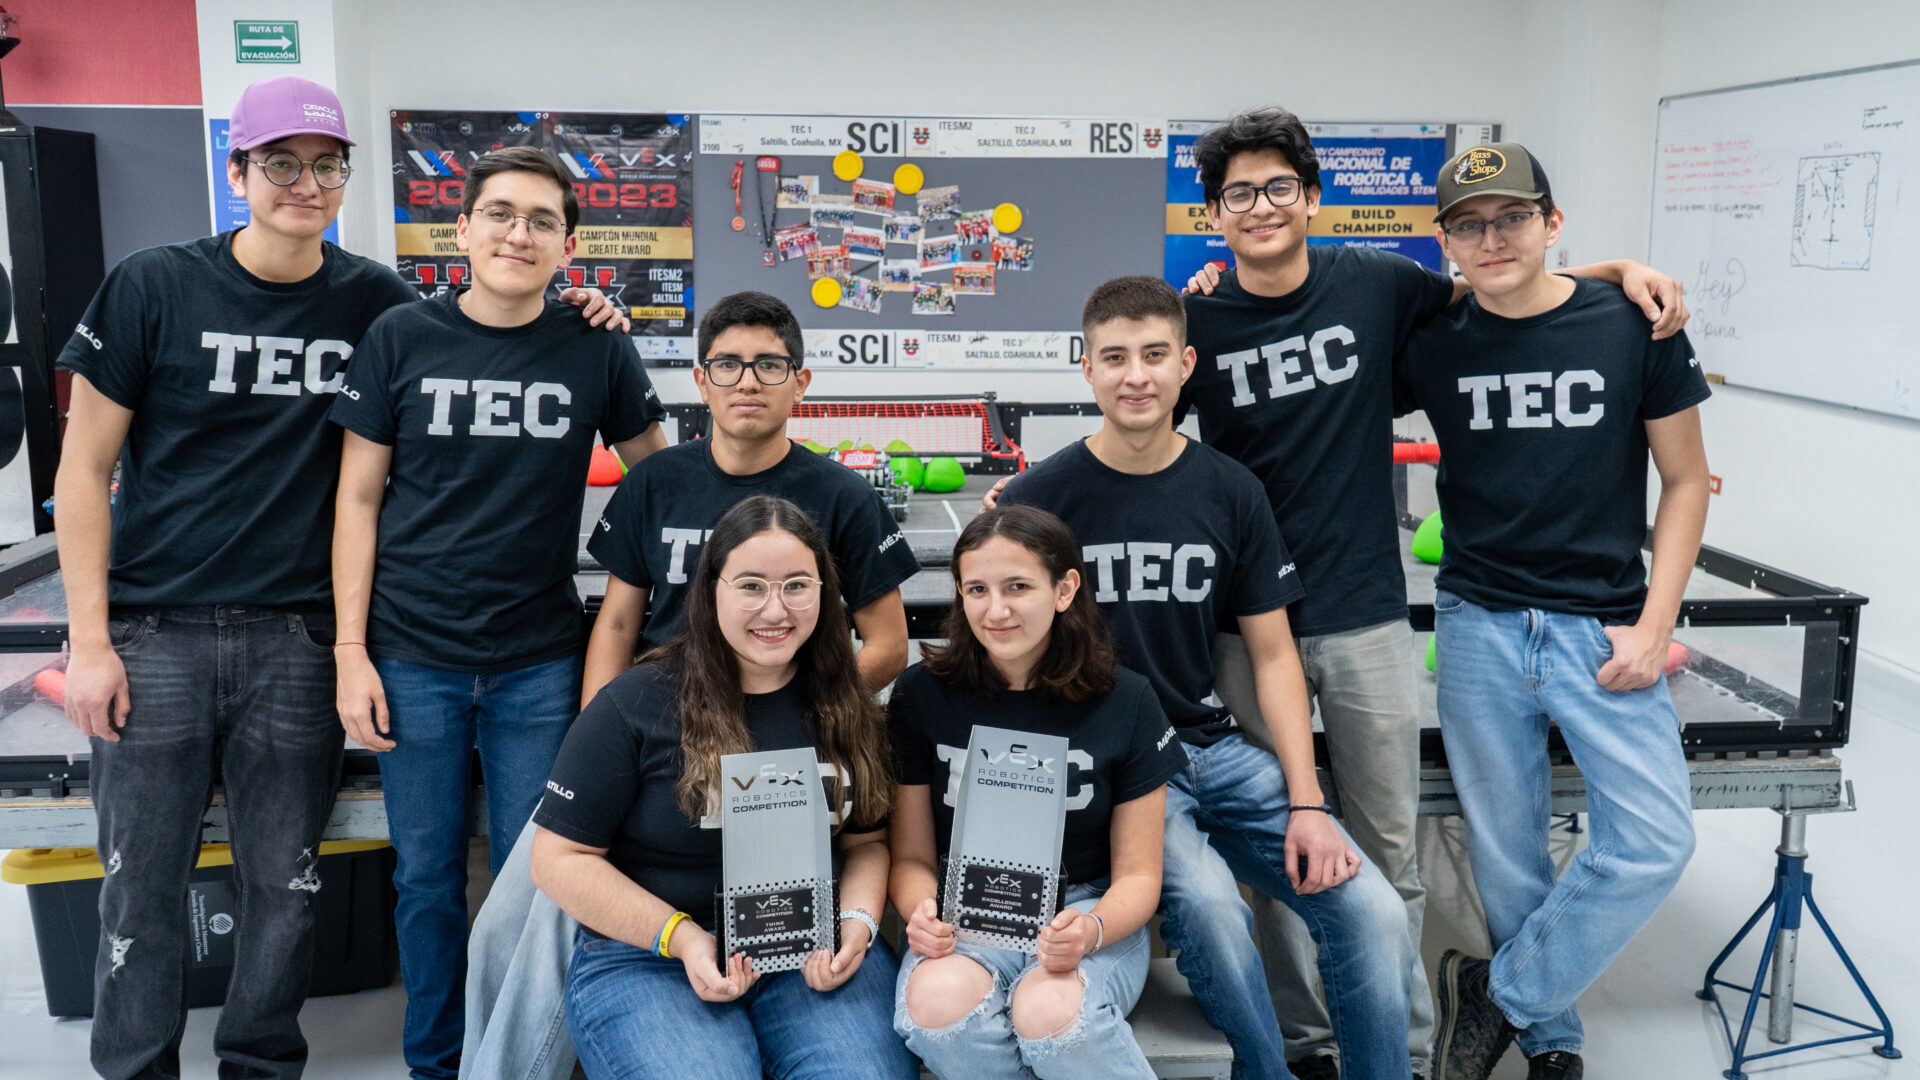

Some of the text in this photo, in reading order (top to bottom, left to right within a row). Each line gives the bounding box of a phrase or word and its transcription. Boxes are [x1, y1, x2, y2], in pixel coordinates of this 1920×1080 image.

[241, 51, 296, 60] EVACUACIÓN
[302, 103, 338, 115] ORACLE
[790, 125, 806, 134] TEC
[938, 121, 973, 131] ITESM2
[1014, 126, 1036, 135] TEC 2
[760, 137, 789, 147] Saltillo,
[791, 138, 826, 147] Coahuila,
[847, 121, 899, 154] SCI
[1059, 139, 1072, 147] MX
[1090, 122, 1133, 154] RES
[702, 143, 720, 152] 3100
[1328, 147, 1386, 156] CAMPEONATO
[619, 147, 677, 167] VEX
[1470, 151, 1492, 160] Bass
[1318, 156, 1413, 171] NACIONAL DE
[1469, 158, 1486, 169] Pro
[1469, 164, 1498, 176] Shops
[1333, 170, 1424, 186] ROBÓTICA &
[408, 180, 465, 205] 20
[571, 182, 677, 208] 2023
[1350, 185, 1437, 195] HABILIDADES STEM
[1351, 209, 1396, 219] BUILD
[430, 228, 458, 239] CAMPE
[1332, 223, 1413, 233] CHAMPION
[579, 229, 659, 242] CAMPEÓN MUNDIAL
[588, 244, 651, 255] CREATE AWARD
[1345, 240, 1400, 249] Nivel Superior
[649, 268, 683, 281] ITESM2
[661, 283, 684, 292] ITESM
[652, 293, 684, 304] SALTILLO
[1002, 338, 1016, 347] TEC
[820, 350, 833, 358] MX
[838, 334, 889, 364] SCI
[1046, 351, 1059, 359] MX
[201, 331, 354, 396] TEC
[1216, 324, 1359, 408] TEC
[1457, 369, 1605, 430] TEC
[420, 377, 572, 439] TEC
[878, 530, 904, 554] MÉX
[1082, 541, 1217, 603] TEC
[980, 743, 1056, 774] VEX
[731, 763, 805, 791] VEX
[936, 743, 1094, 811] TC
[978, 767, 1055, 785] ROBOTICS
[977, 777, 1054, 795] COMPETITION
[732, 789, 807, 803] ROBOTICS
[732, 799, 807, 813] COMPETITION
[986, 873, 1022, 888] VEX
[984, 884, 1022, 893] ROBOTICS
[984, 888, 1022, 898] COMPETITION
[755, 894, 793, 910] VEX
[981, 896, 1022, 907] EXCELLENCE
[989, 903, 1013, 911] AWARD
[755, 906, 793, 914] ROBOTICS
[755, 910, 794, 919] COMPETITION
[764, 925, 786, 933] AWARD
